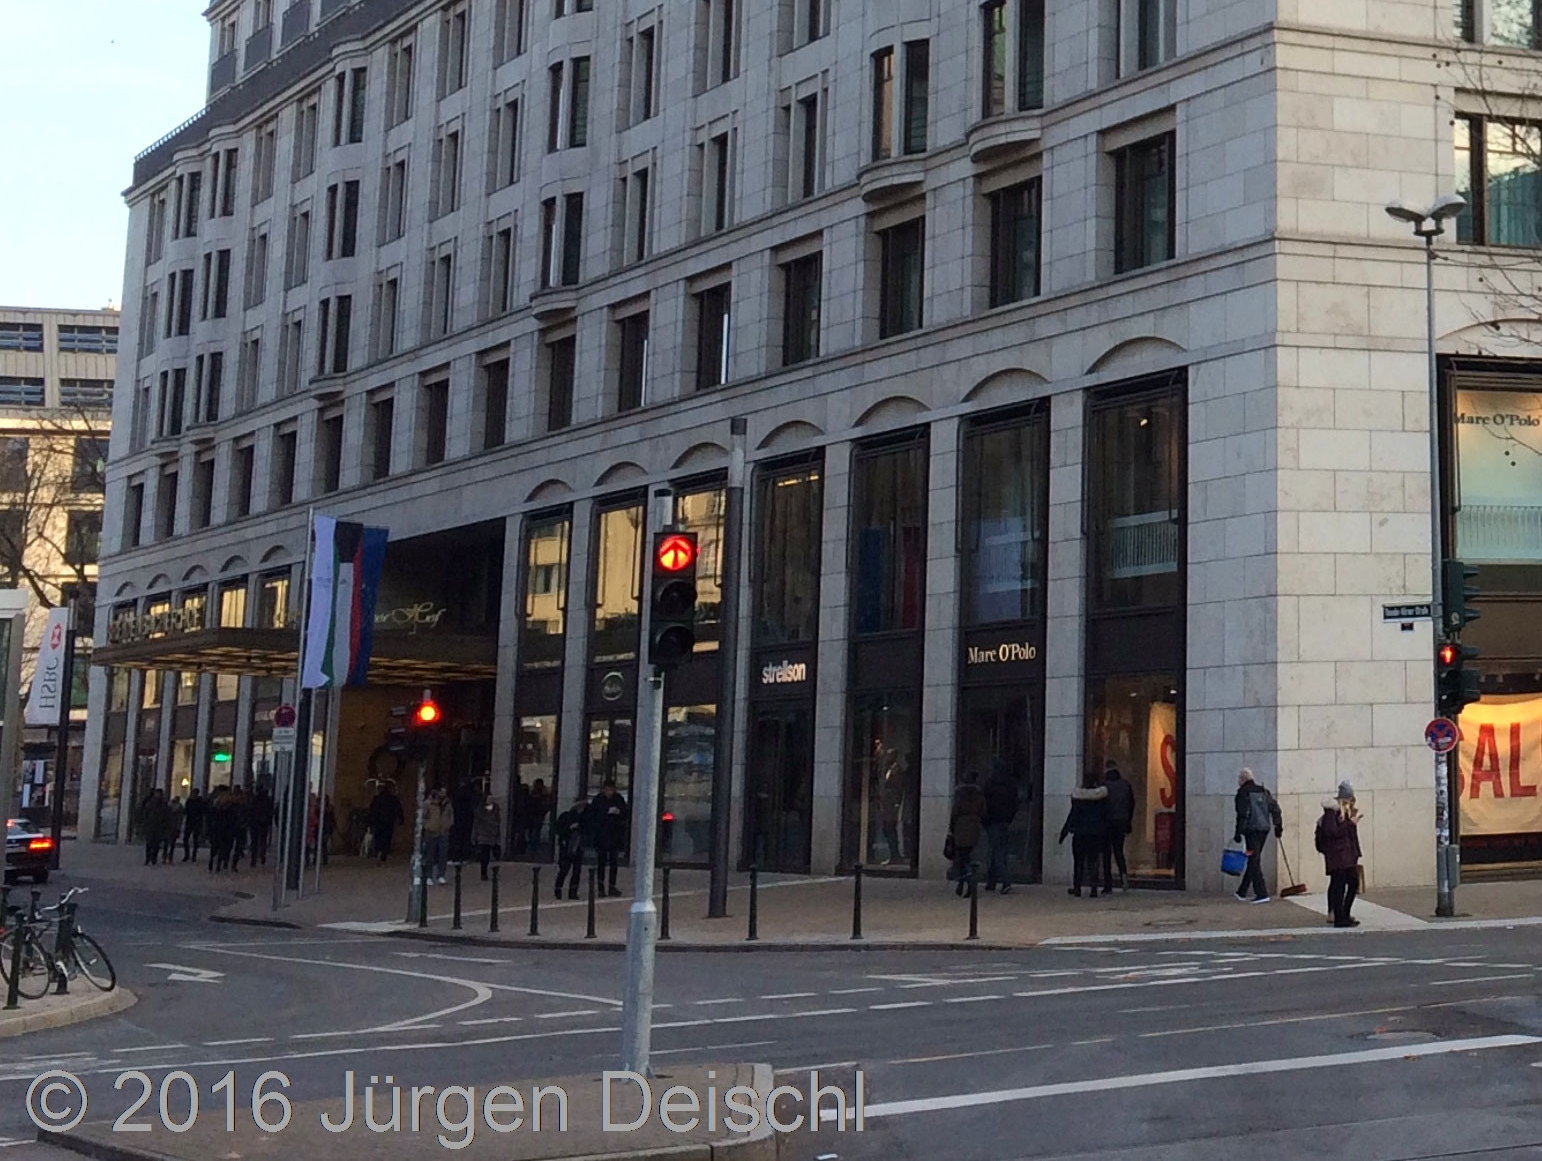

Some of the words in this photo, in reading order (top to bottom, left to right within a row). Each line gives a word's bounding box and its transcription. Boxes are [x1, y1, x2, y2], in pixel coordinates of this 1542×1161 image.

[967, 646, 998, 664] Marc
[999, 642, 1037, 662] O'Polo
[761, 660, 806, 684] strellson
